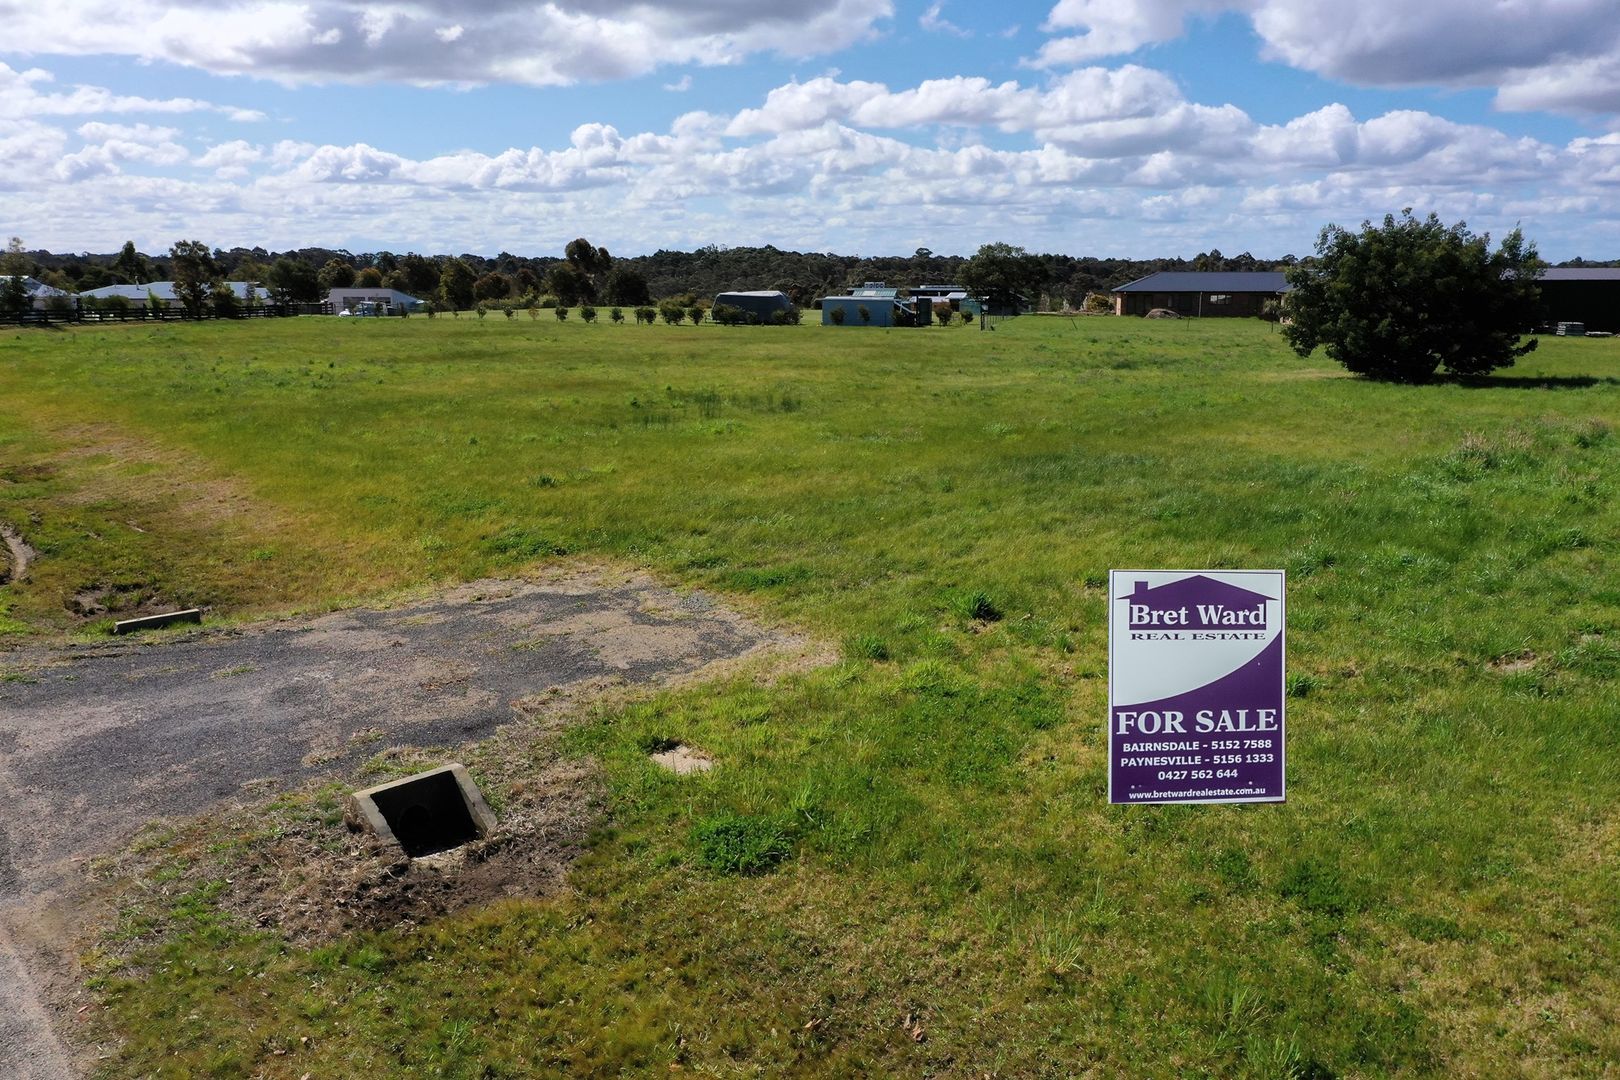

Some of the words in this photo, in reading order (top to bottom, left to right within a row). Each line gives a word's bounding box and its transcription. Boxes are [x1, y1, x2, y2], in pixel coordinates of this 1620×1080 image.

[1130, 604, 1189, 625] Bret
[1197, 604, 1265, 625] Ward
[1116, 711, 1187, 734] FOR
[1195, 709, 1278, 732] SALE
[1123, 742, 1199, 752] BAIRNSDALE
[1211, 741, 1240, 749] 5152
[1243, 740, 1272, 748] 7588
[1121, 756, 1201, 767] PAYNESVILLE
[1213, 755, 1242, 764] 5156
[1246, 754, 1273, 762] 1333
[1158, 771, 1187, 780] 0427
[1191, 770, 1213, 779] 562
[1217, 769, 1238, 778] 644
[1129, 788, 1265, 799] www.bretwardrealestate.com.au
